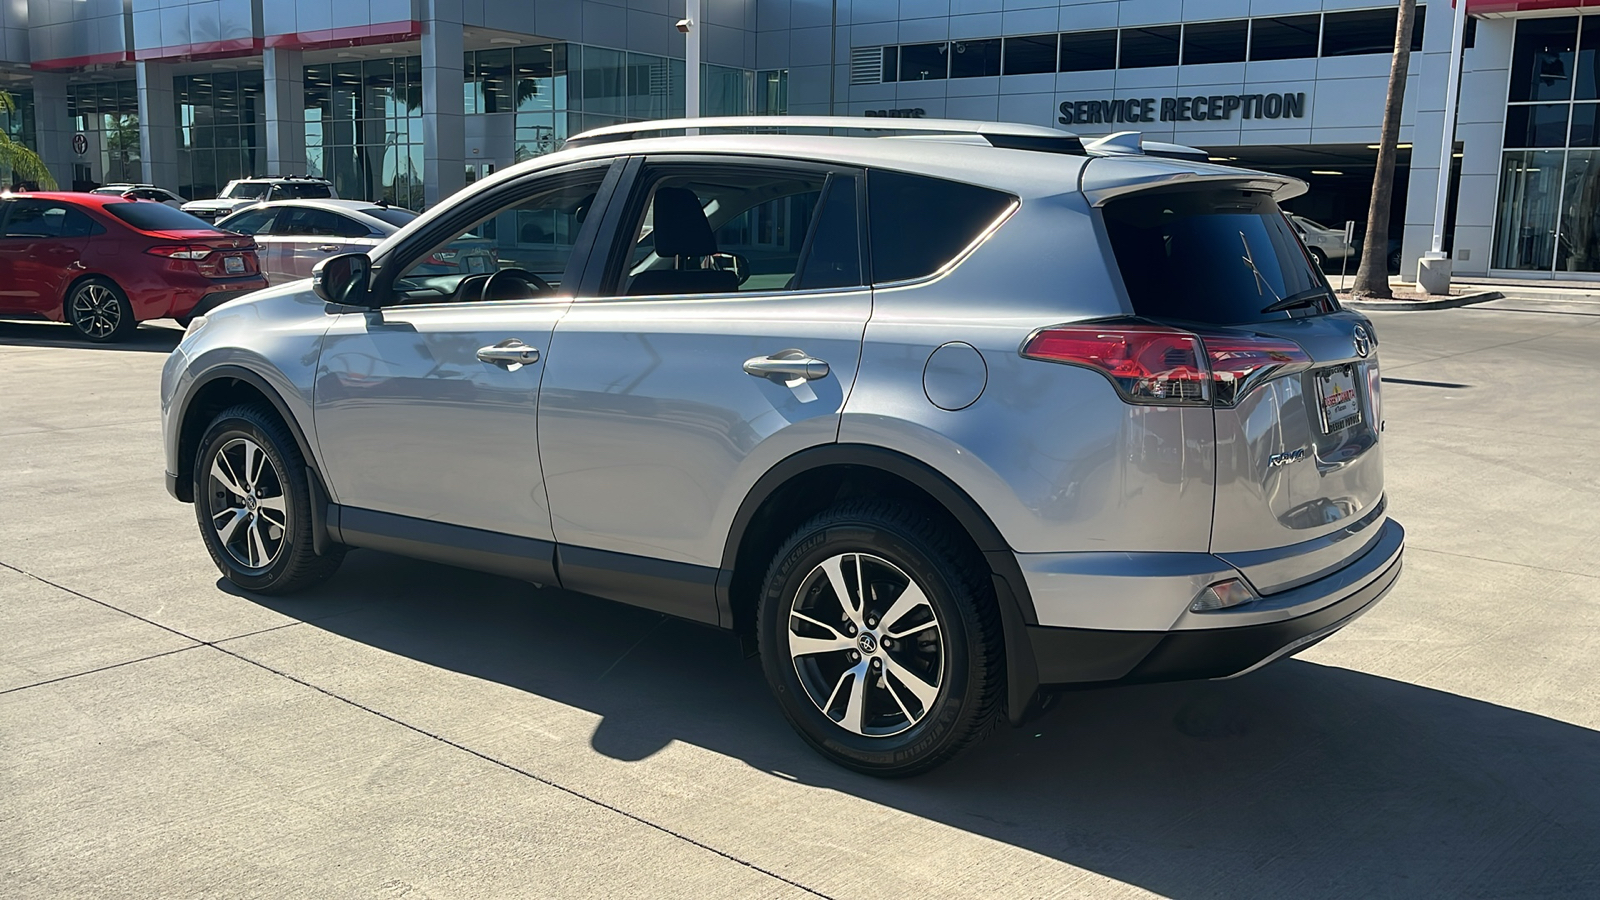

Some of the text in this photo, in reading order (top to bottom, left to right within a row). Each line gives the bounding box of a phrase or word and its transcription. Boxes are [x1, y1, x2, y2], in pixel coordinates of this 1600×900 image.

[1059, 92, 1305, 124] SERVICE RECEPTION
[781, 533, 825, 574] MICHELIN
[896, 723, 945, 762] MICHELIN
